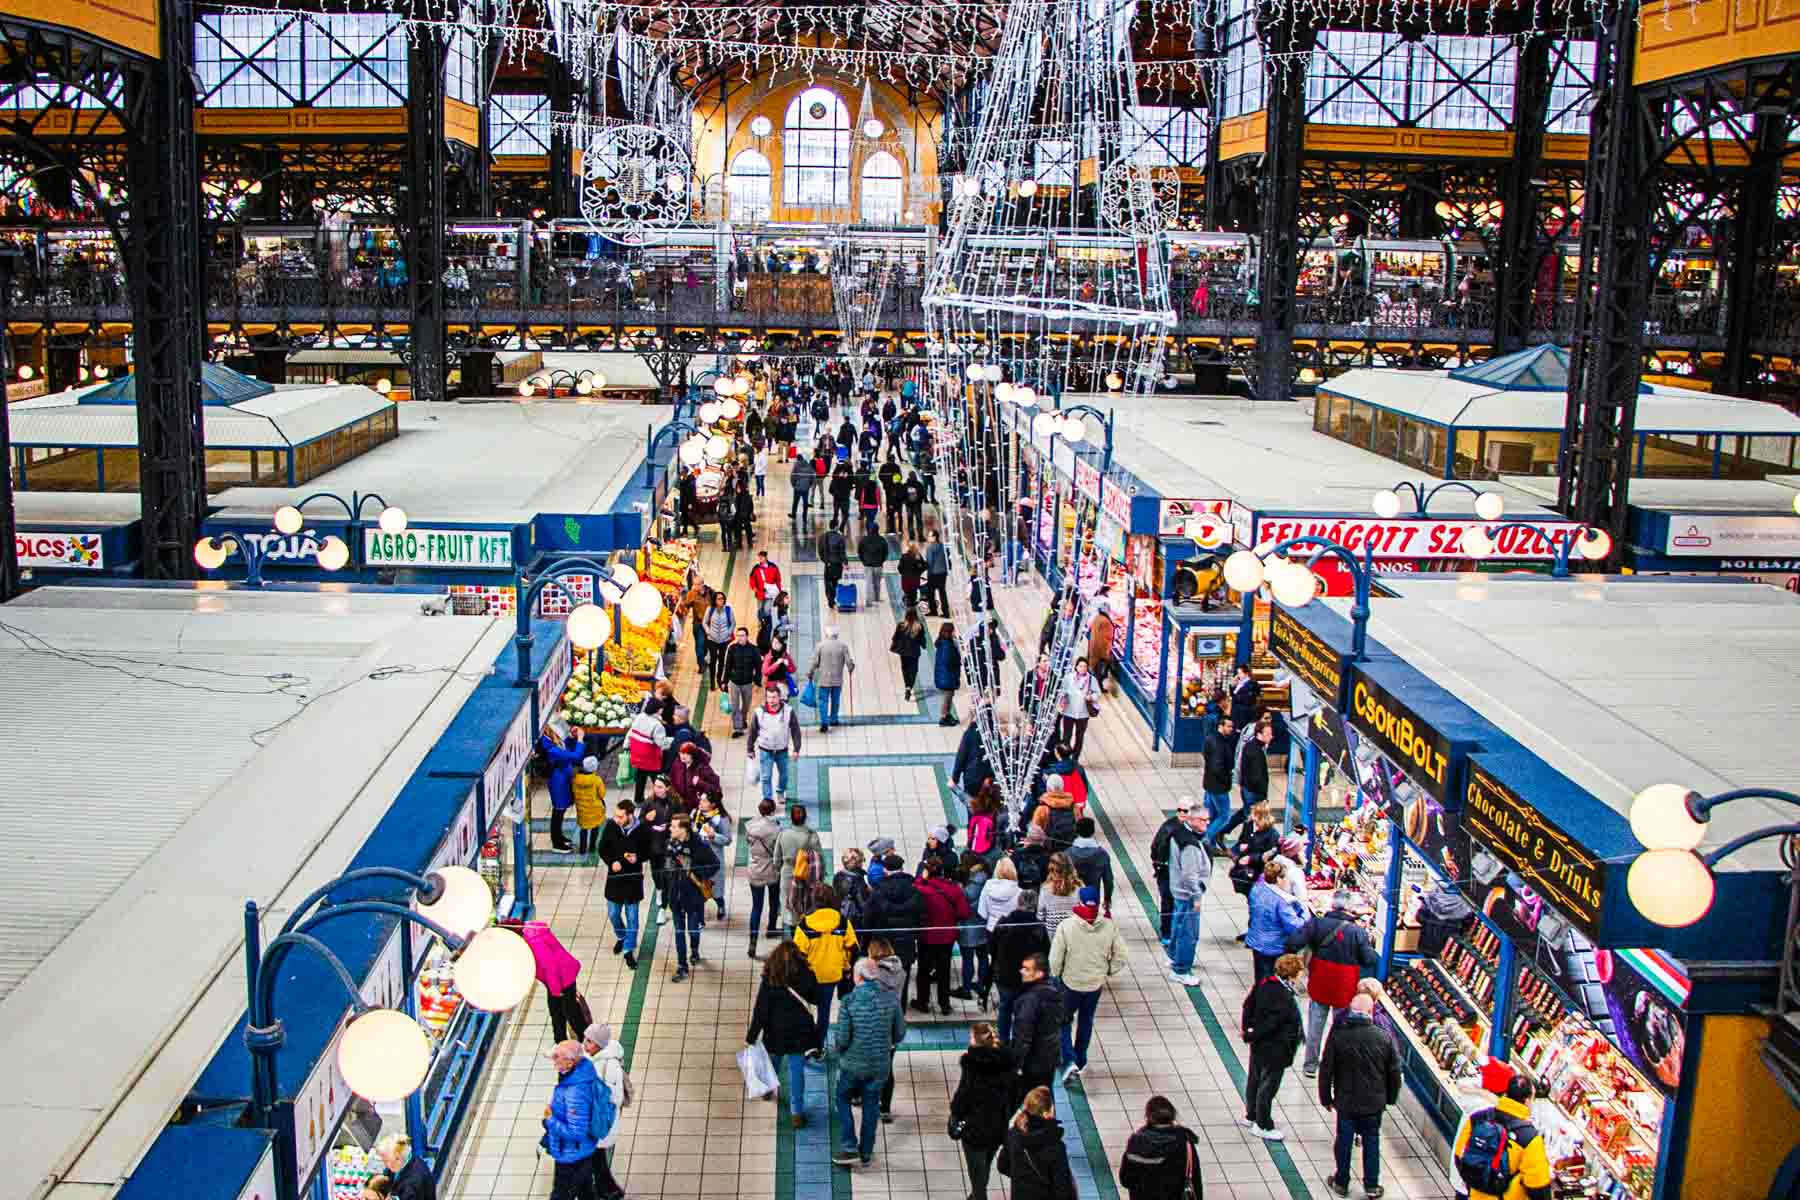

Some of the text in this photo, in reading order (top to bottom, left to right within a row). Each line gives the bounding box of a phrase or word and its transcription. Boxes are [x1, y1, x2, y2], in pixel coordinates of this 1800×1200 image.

[243, 529, 320, 559] TOJÁ
[371, 532, 511, 564] AGRO-FRUIT KFT.
[1467, 783, 1601, 908] Chocolate & Drinks
